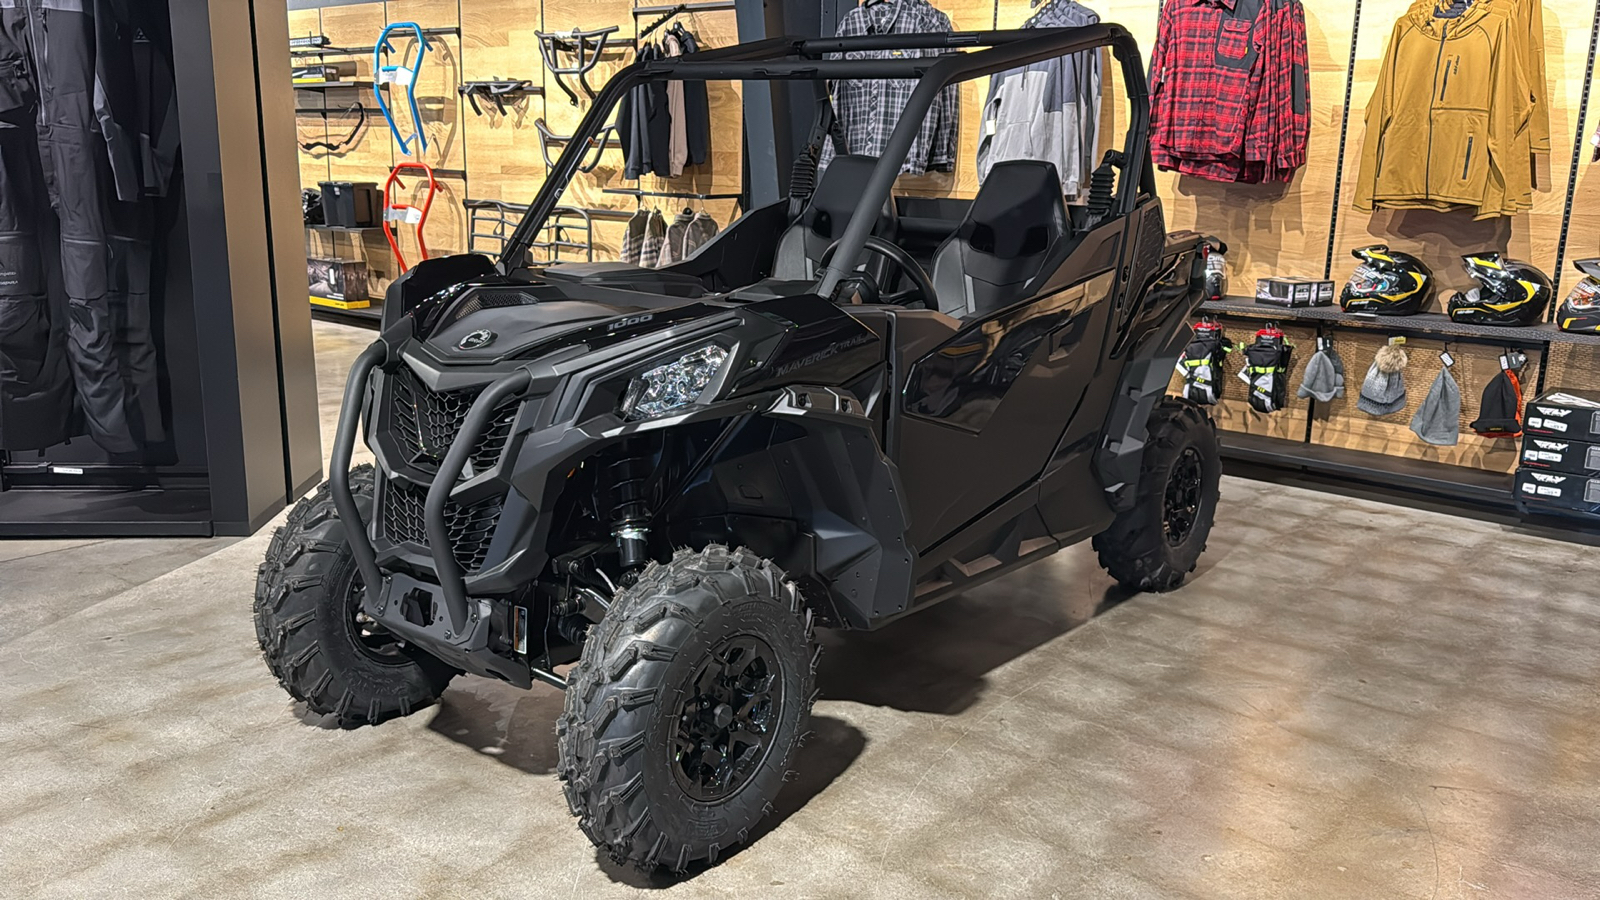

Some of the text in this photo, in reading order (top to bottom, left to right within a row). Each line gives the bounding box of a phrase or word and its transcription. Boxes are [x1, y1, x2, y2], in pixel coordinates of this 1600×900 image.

[607, 314, 653, 331] 1000
[776, 333, 867, 377] MAVERICK TRAIL
